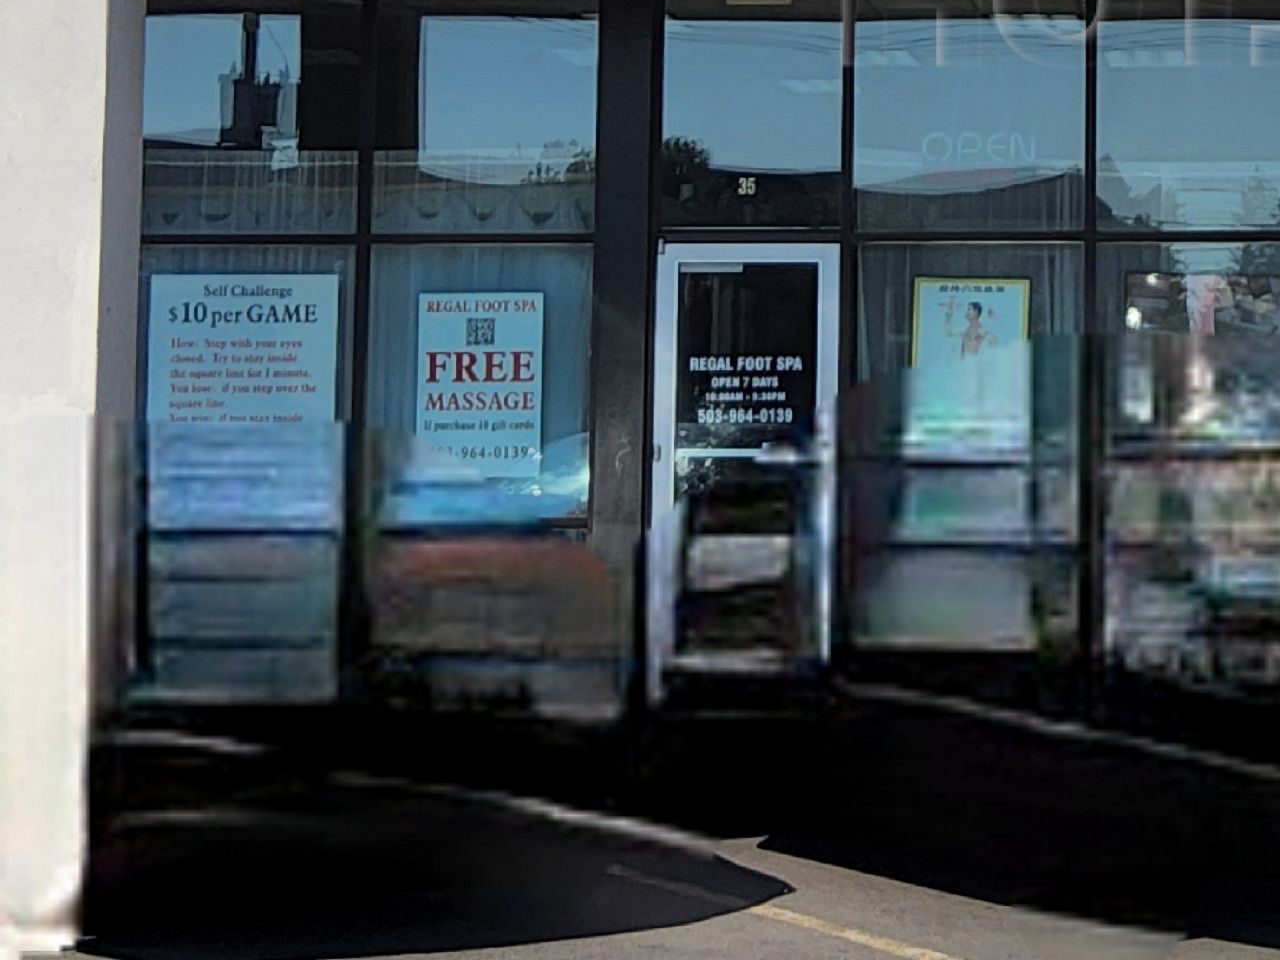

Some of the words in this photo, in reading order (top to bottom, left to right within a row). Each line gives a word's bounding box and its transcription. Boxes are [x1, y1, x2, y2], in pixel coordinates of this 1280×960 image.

[921, 131, 1036, 162] OPEN
[737, 176, 757, 195] 35
[203, 285, 228, 297] Self
[231, 285, 293, 299] Challenge
[168, 301, 208, 323] $10
[211, 307, 243, 328] per
[246, 303, 319, 324] GAME
[426, 300, 472, 313] REGAL
[475, 300, 511, 313] FOOT
[514, 299, 537, 313] SPA
[425, 351, 536, 383] FREE
[689, 356, 734, 371] REGAL
[737, 356, 773, 371] FOOT
[776, 356, 803, 371] SPA
[711, 376, 740, 388] OPEN
[743, 376, 750, 388] 7
[752, 376, 779, 388] DAYS
[424, 392, 536, 411] MASSAGE
[697, 407, 794, 424] 503-964-0139
